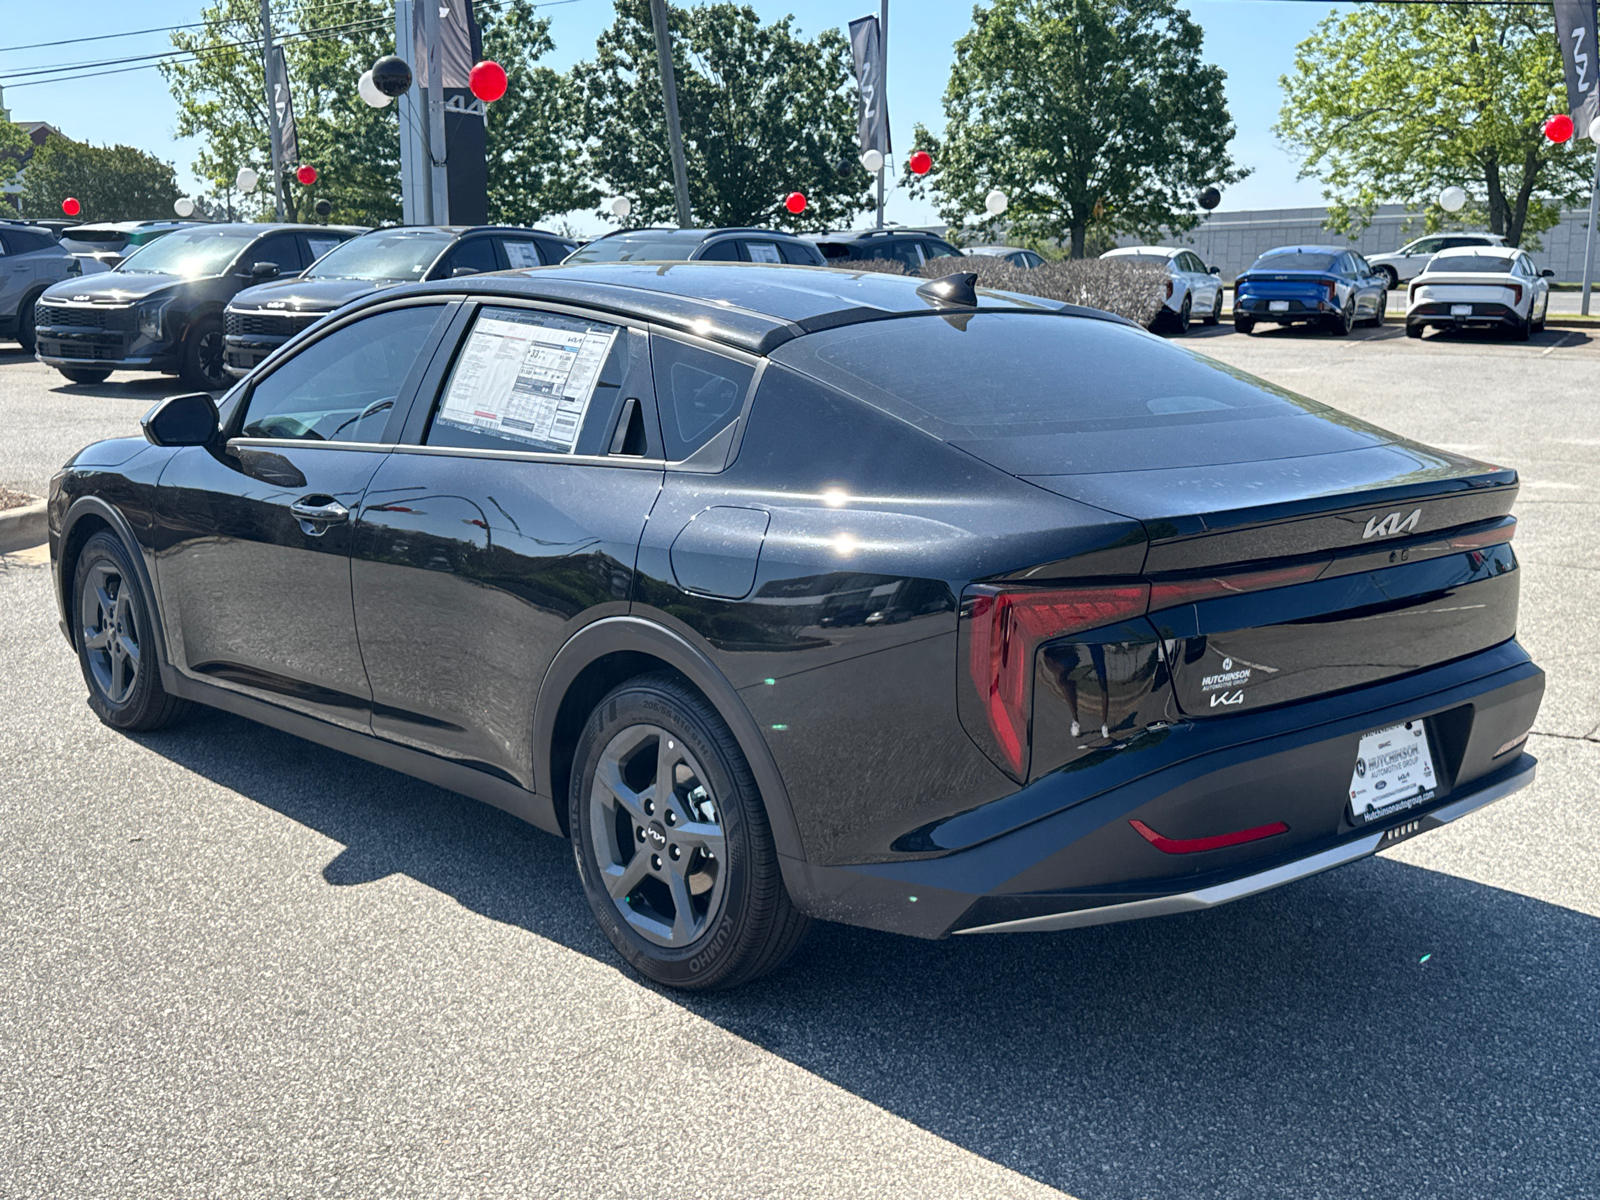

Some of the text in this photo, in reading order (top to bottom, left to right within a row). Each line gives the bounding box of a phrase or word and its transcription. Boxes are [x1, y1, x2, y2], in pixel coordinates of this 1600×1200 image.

[1362, 508, 1421, 539] KIA
[1201, 669, 1251, 686] HUTCHINSON
[1202, 677, 1249, 692] AUTOMOTIVE GROUP
[642, 700, 672, 719] 205/55
[1210, 689, 1244, 708] K4
[1368, 744, 1420, 771] HUTCHINSON
[1371, 756, 1419, 779] AUTOMOTIVE GROUP
[1363, 791, 1435, 822] Hutchinsonautogroup.com
[689, 914, 734, 972] KUMHO
